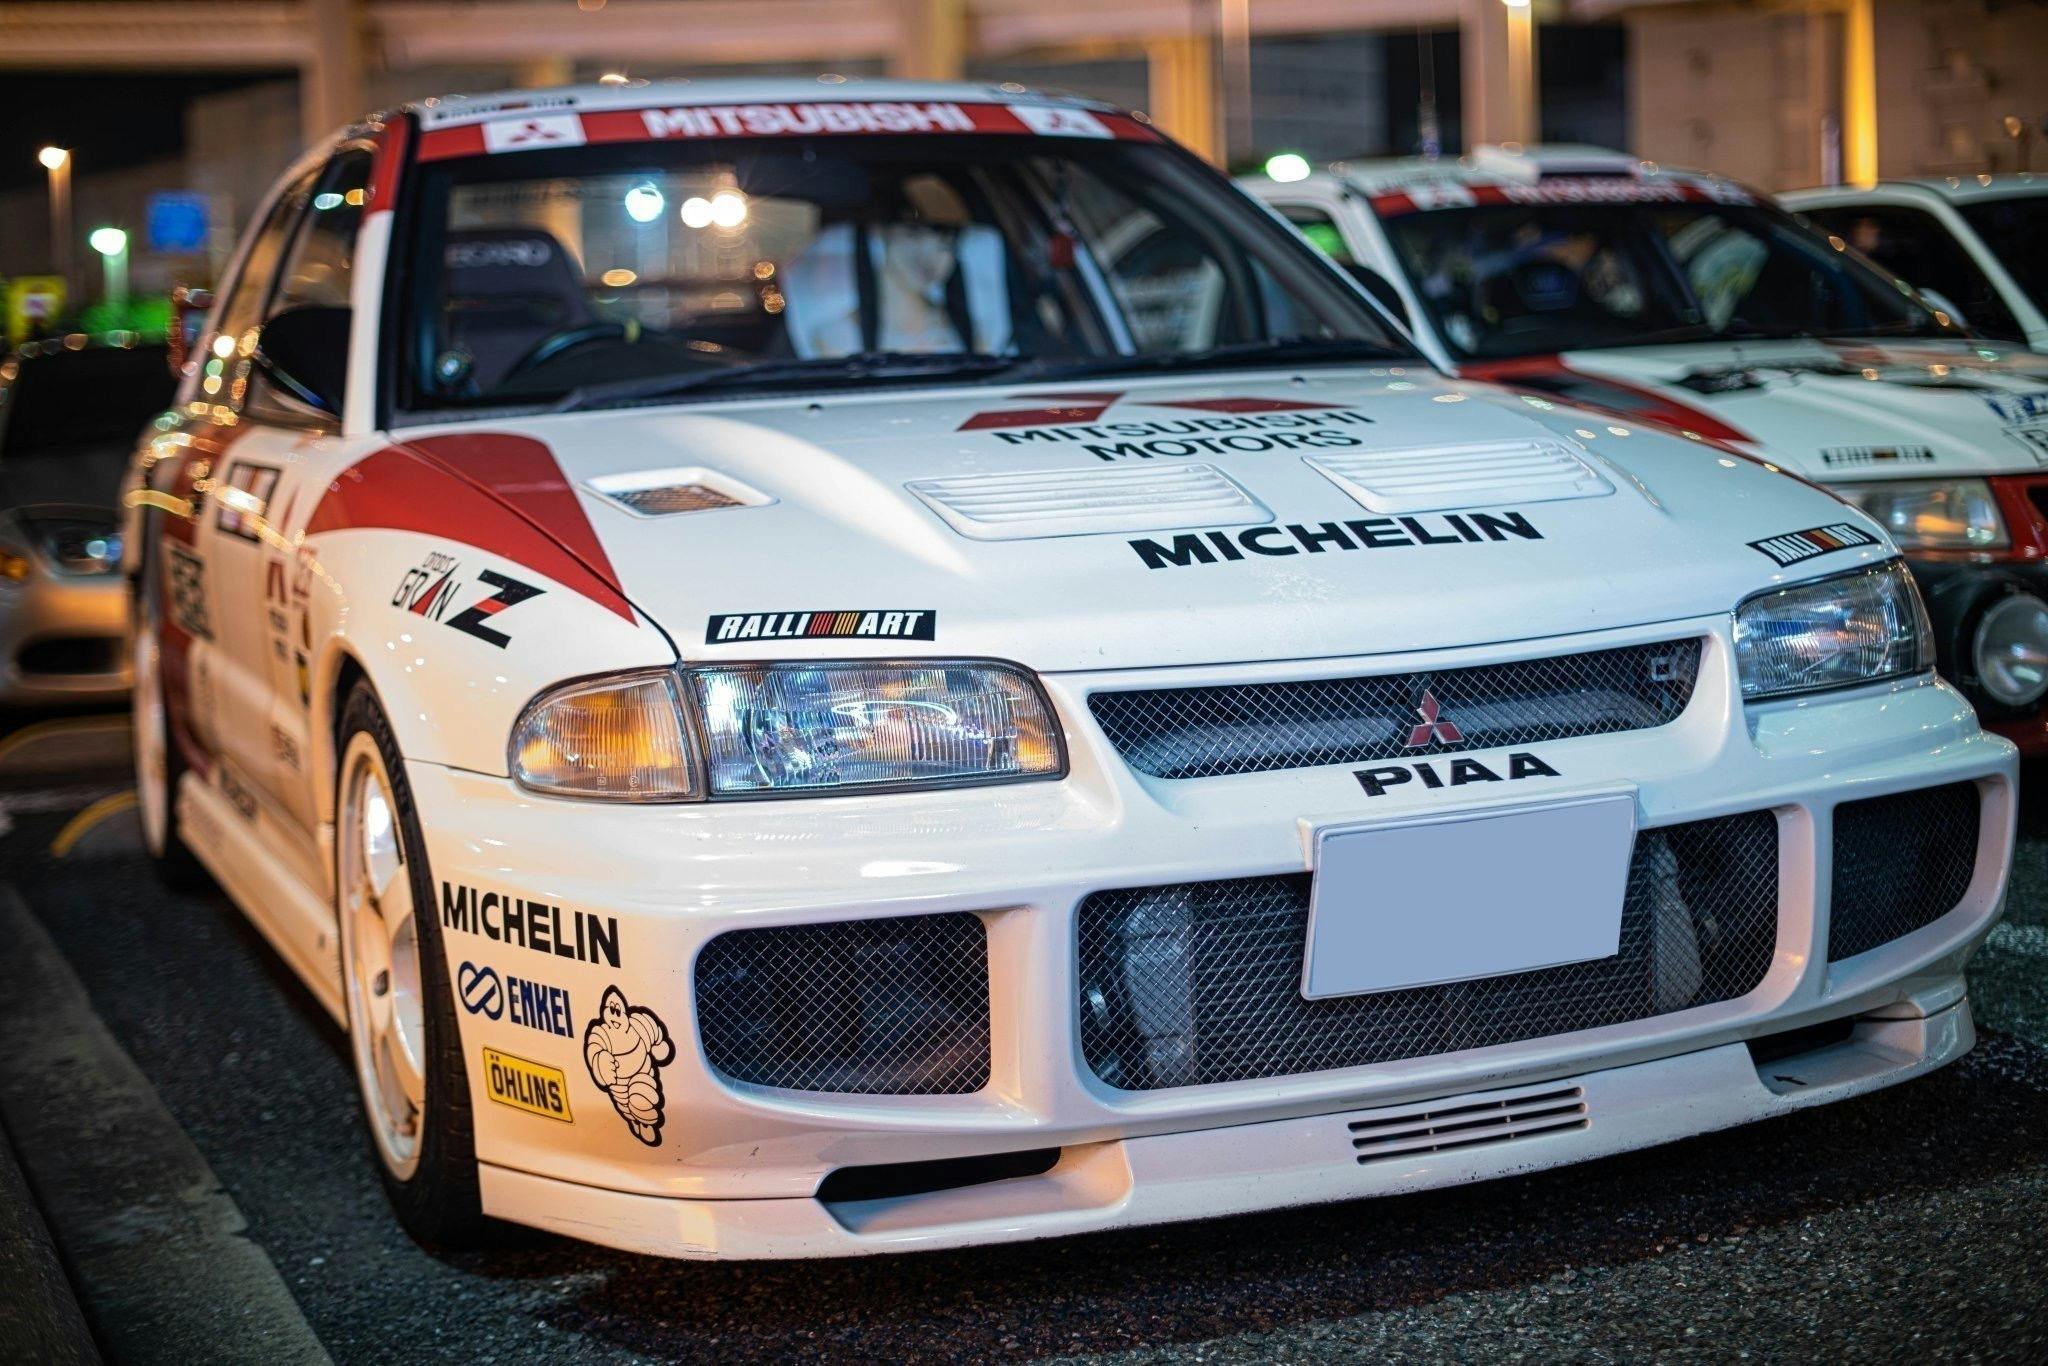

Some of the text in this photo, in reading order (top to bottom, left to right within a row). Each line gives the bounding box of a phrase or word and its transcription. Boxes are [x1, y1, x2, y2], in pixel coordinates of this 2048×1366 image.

[640, 102, 976, 138] MITSUBISHI
[993, 411, 1376, 446] MITSUBISHI
[1088, 429, 1363, 462] MOTORS
[1128, 511, 1544, 570] MICHELIN
[391, 562, 461, 622] GRAN
[444, 568, 548, 650] Z
[858, 611, 924, 636] ART
[1352, 753, 1562, 797] PIAA
[442, 881, 622, 969] MICHELIN
[506, 975, 575, 1039] ENKEI
[489, 1053, 563, 1113] ÖHLINS
